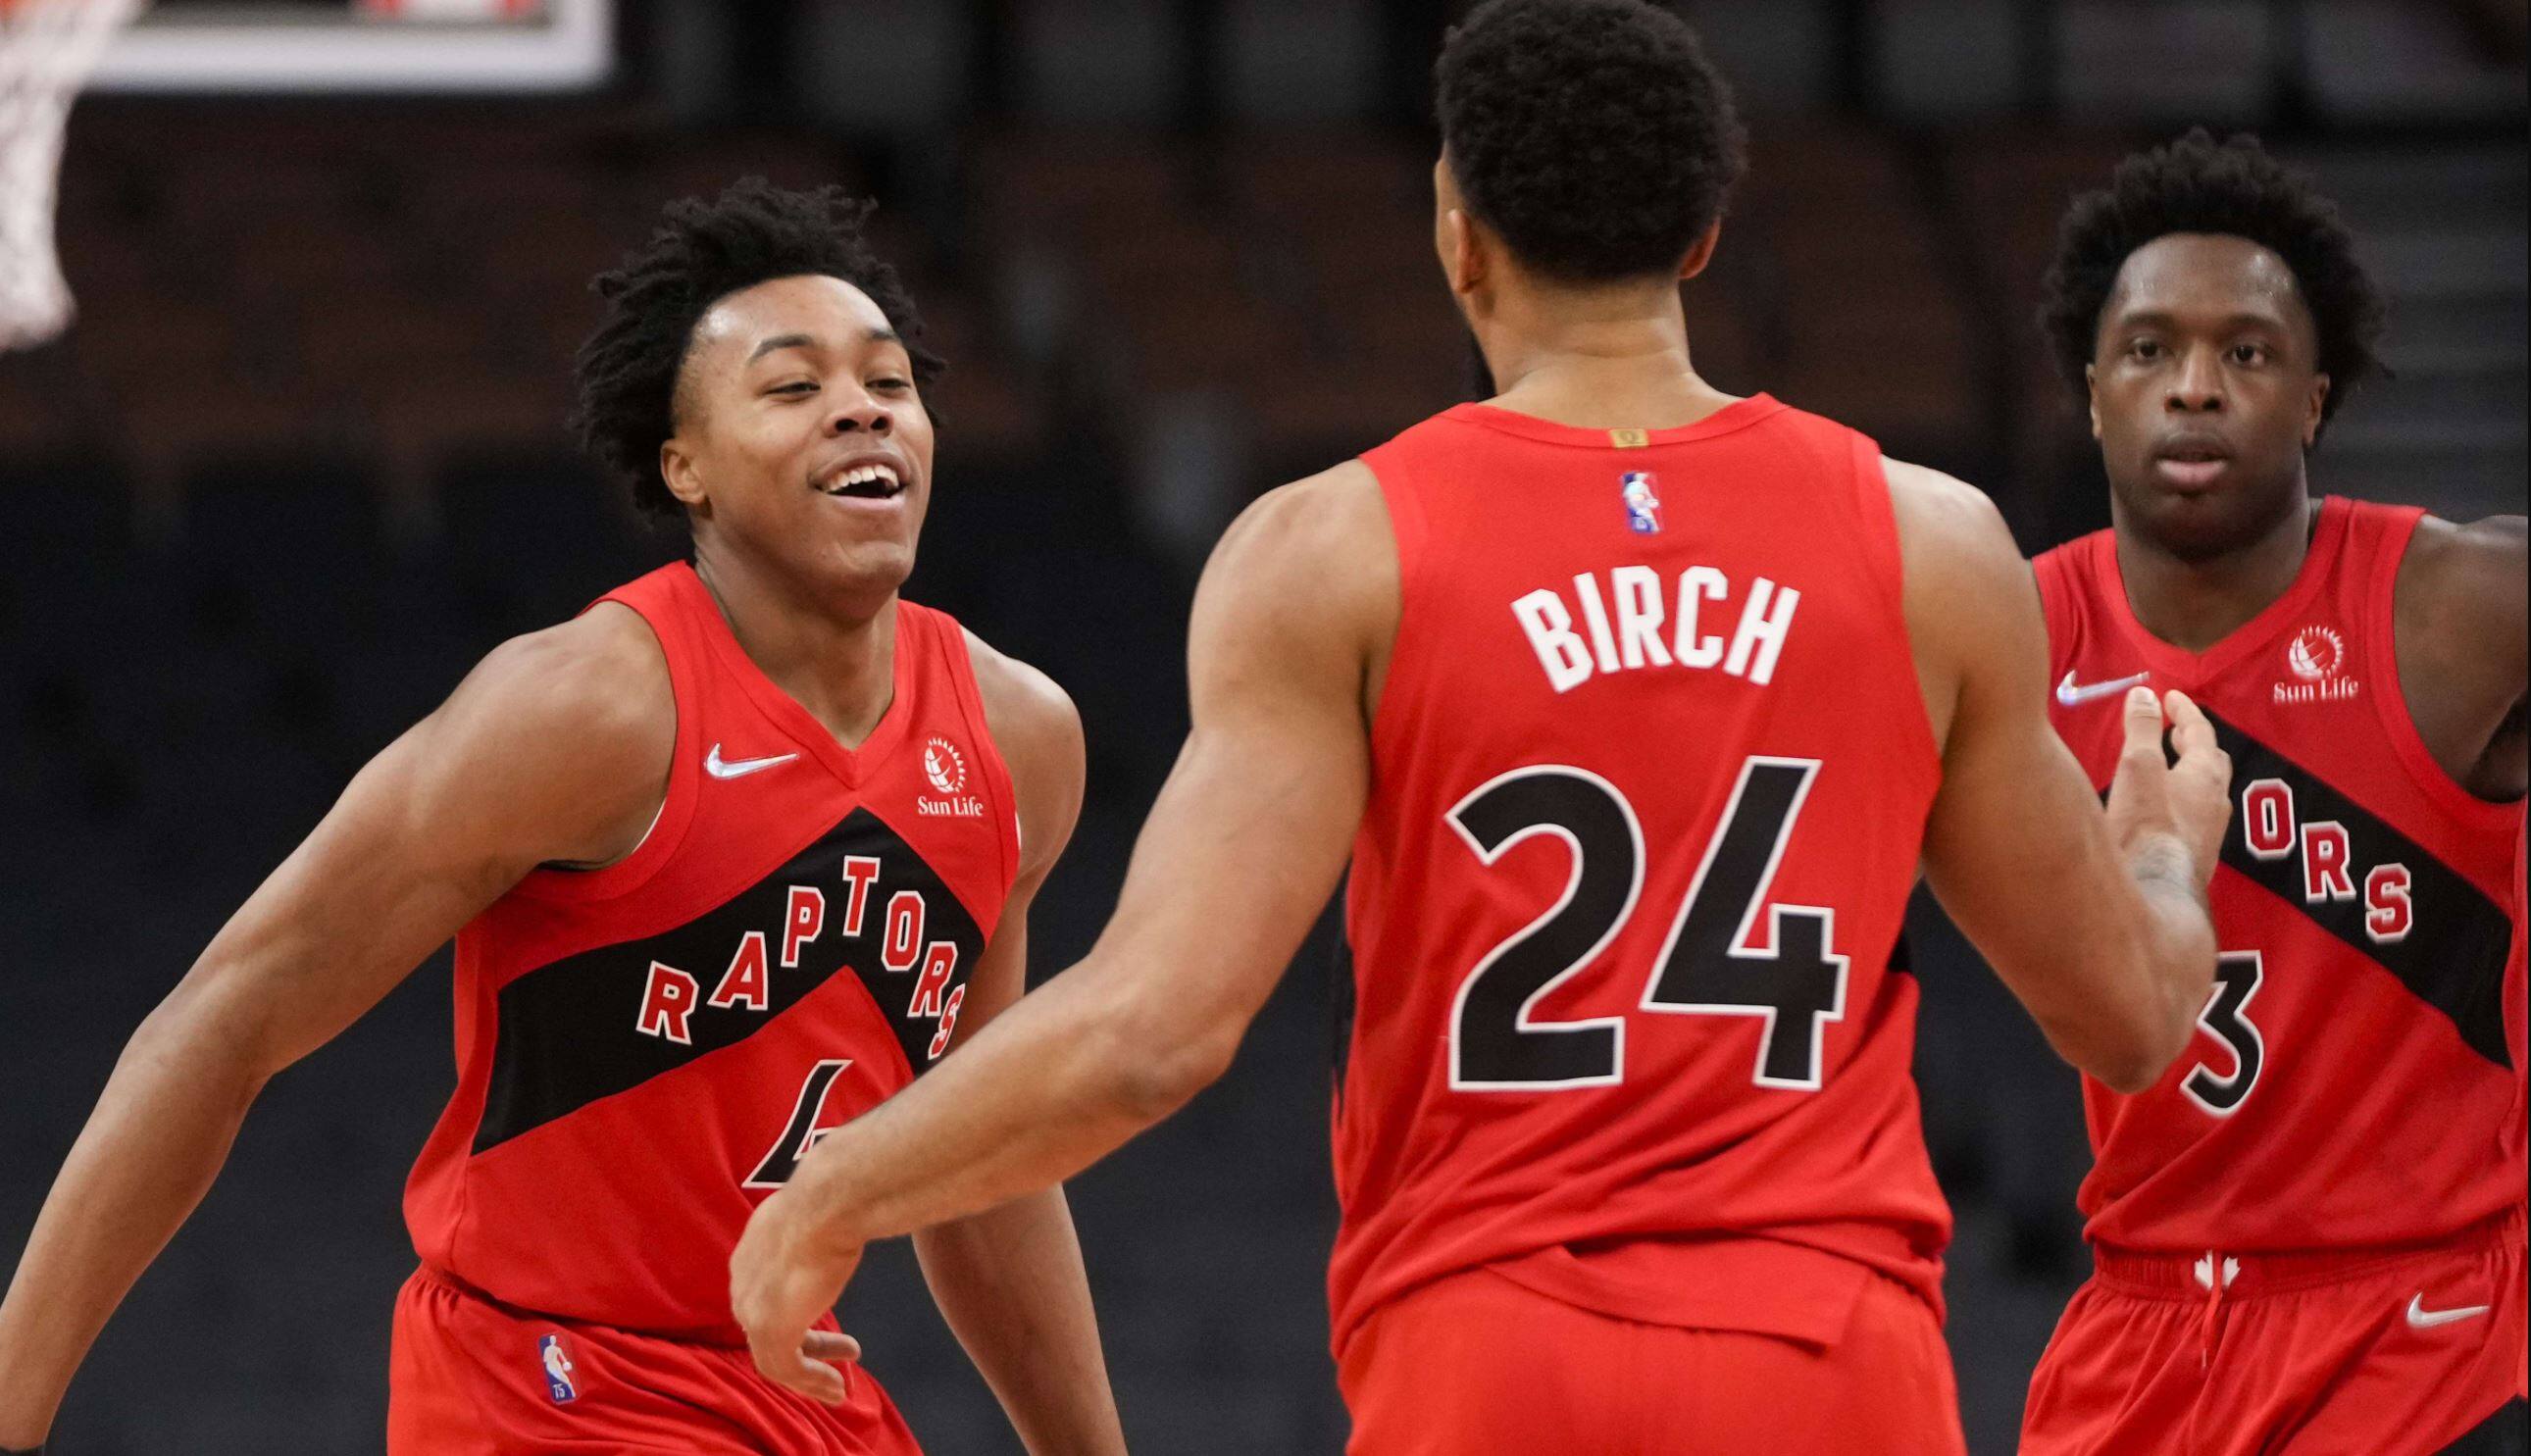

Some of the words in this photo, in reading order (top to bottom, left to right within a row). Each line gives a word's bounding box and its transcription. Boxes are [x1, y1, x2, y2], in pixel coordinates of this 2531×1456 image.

[1510, 565, 1800, 692] BIRCH
[2274, 681, 2314, 704] Sun
[2320, 676, 2358, 701] Life
[917, 795, 951, 816] Sun
[952, 795, 984, 816] Life
[635, 855, 966, 1060] RAPTORS
[1443, 754, 1850, 1092] 24
[2179, 949, 2264, 1118] 3
